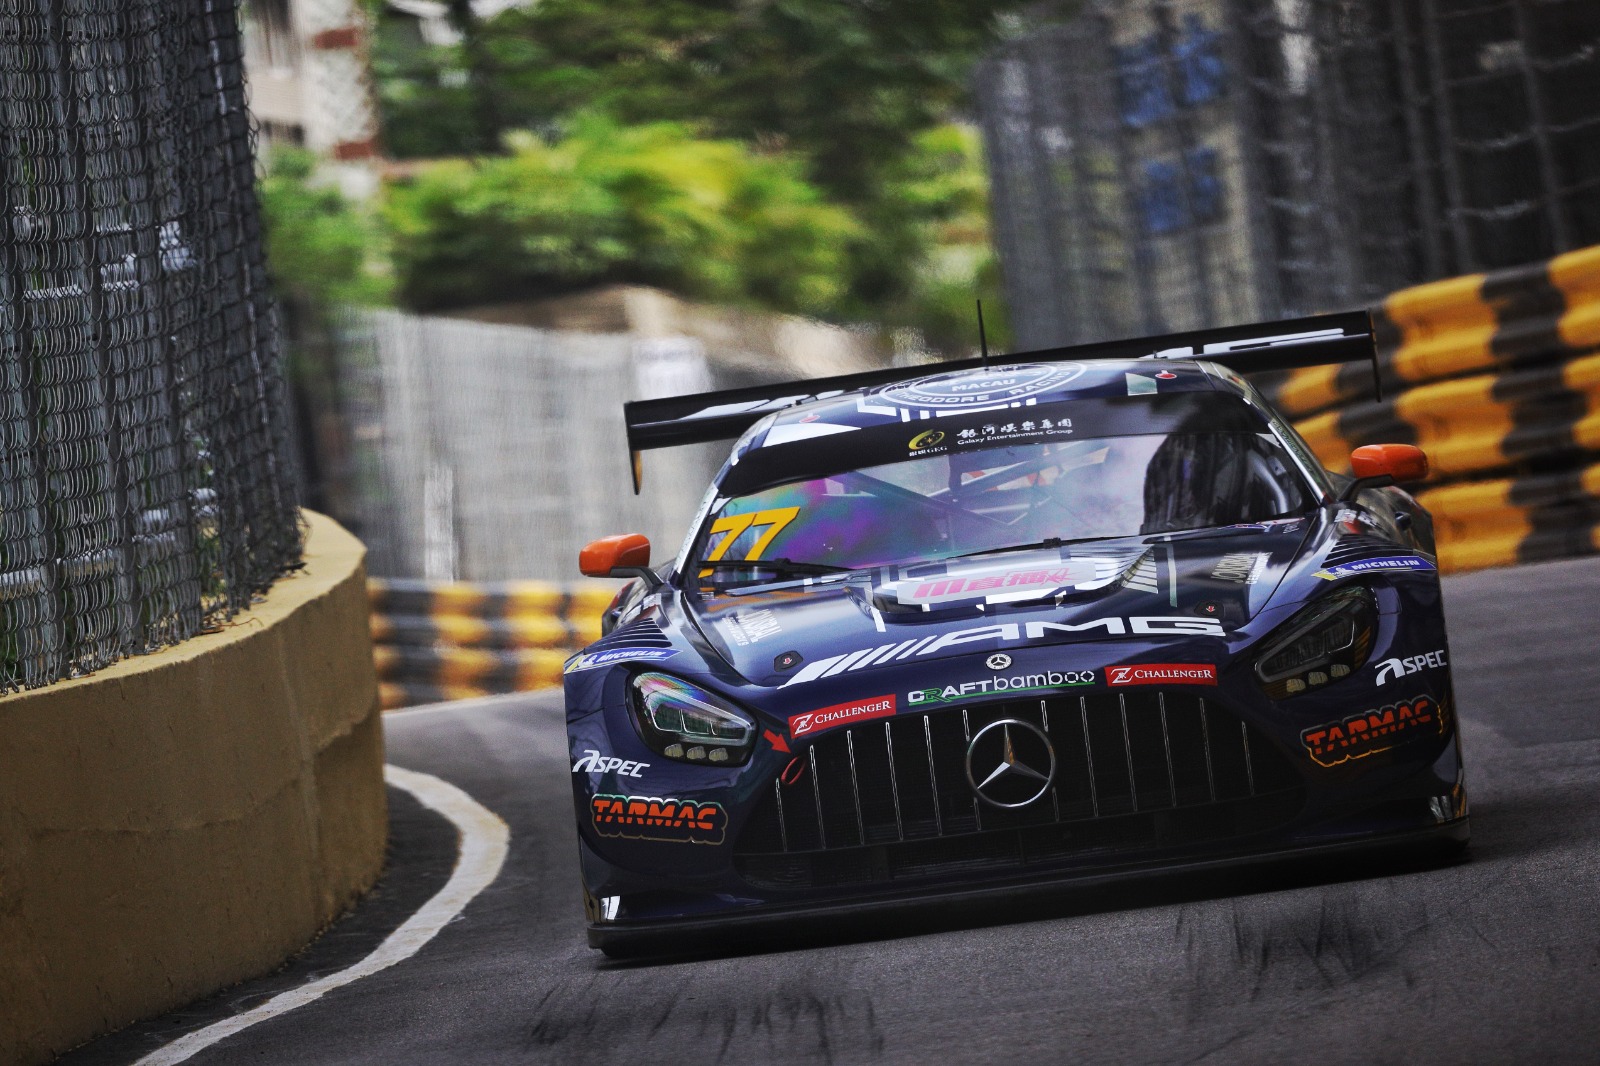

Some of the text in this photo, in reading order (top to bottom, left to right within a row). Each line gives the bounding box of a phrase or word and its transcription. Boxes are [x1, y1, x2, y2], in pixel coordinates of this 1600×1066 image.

[897, 391, 990, 403] THEODORE
[1009, 370, 1071, 396] RACING
[952, 378, 1016, 392] MACAU
[957, 428, 1073, 446] Galaxy Entertainment Group
[698, 506, 800, 579] 77
[1352, 559, 1420, 571] MICHELIN
[916, 616, 1226, 656] AMG
[596, 650, 666, 664] MICHELIN
[1135, 667, 1214, 682] CHALLENGER
[815, 700, 891, 726] CHALLENGER
[1306, 700, 1431, 754] TARMAC
[594, 800, 716, 830] TARMAC
